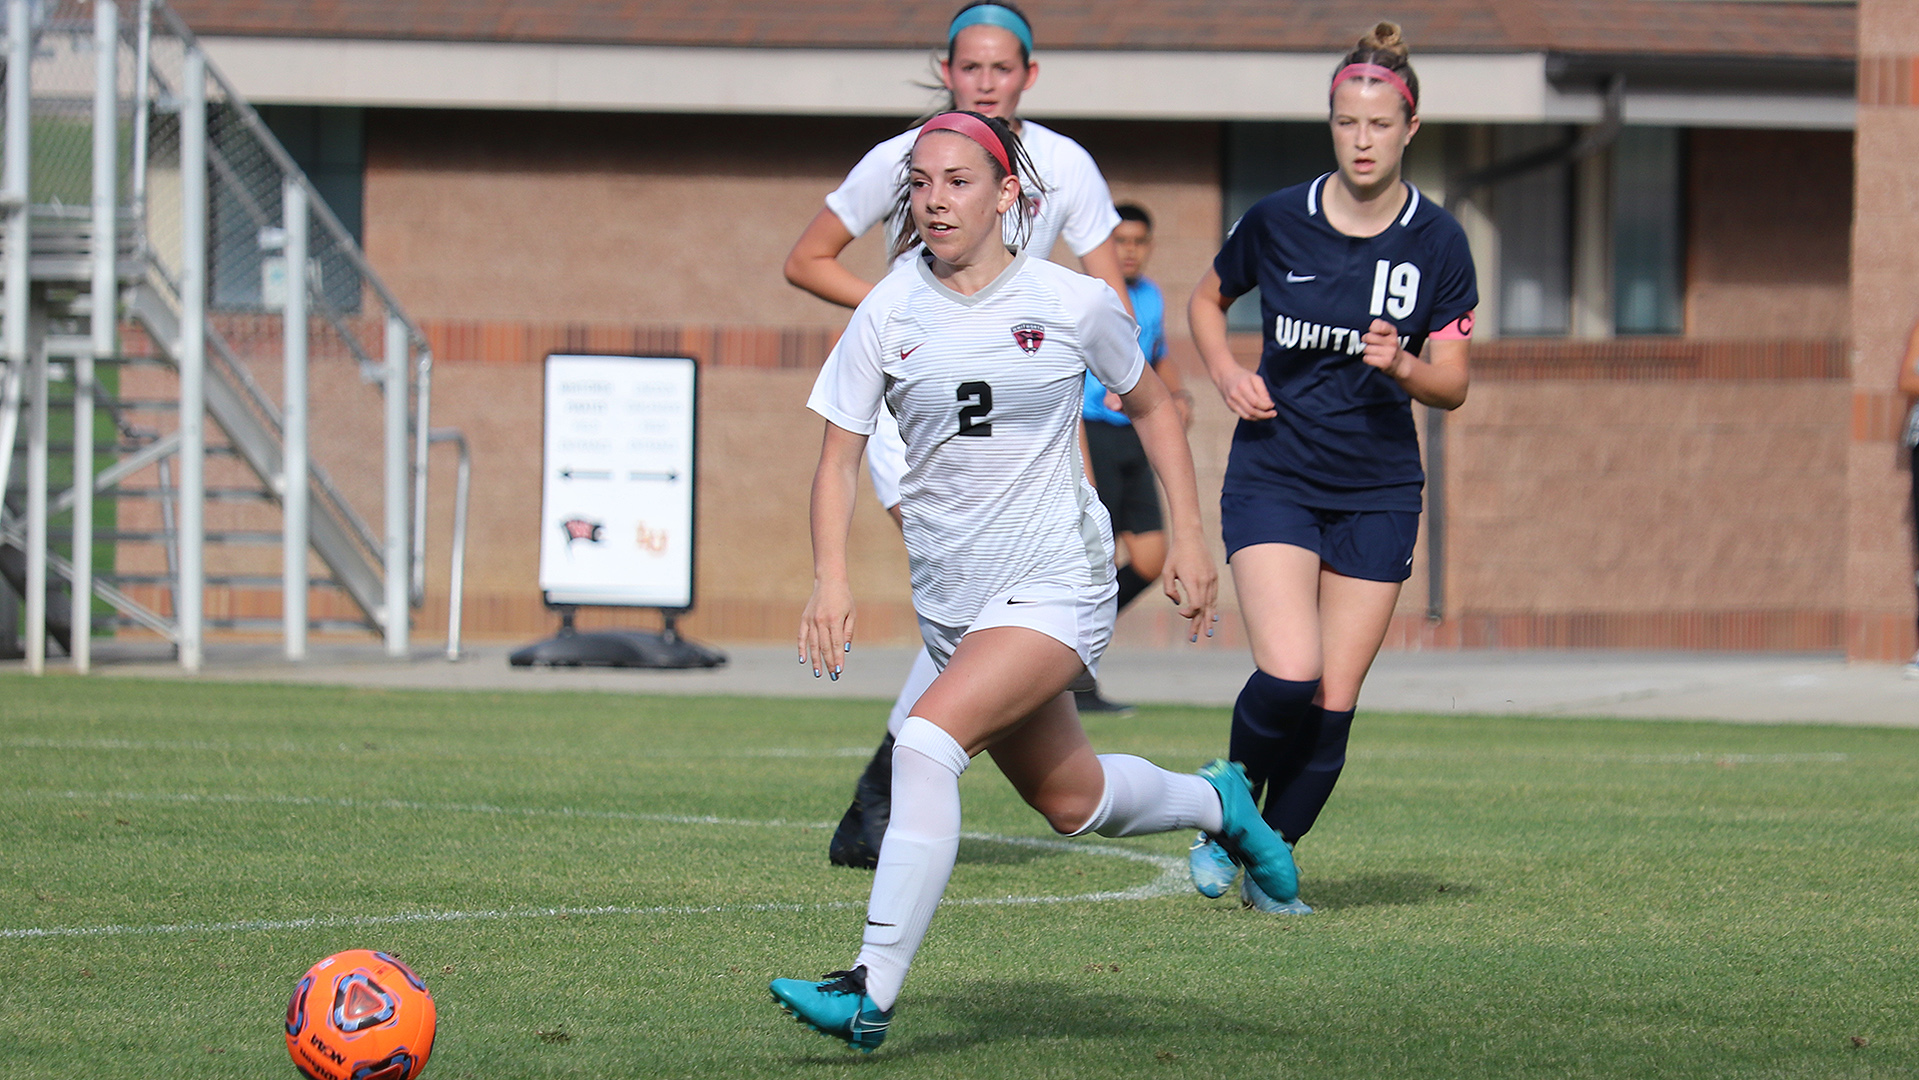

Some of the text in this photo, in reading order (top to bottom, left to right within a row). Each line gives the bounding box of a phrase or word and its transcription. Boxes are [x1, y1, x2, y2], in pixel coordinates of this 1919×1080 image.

[1369, 259, 1420, 320] 19
[1275, 314, 1410, 355] WHITM
[1457, 313, 1472, 336] C
[956, 381, 992, 436] 2
